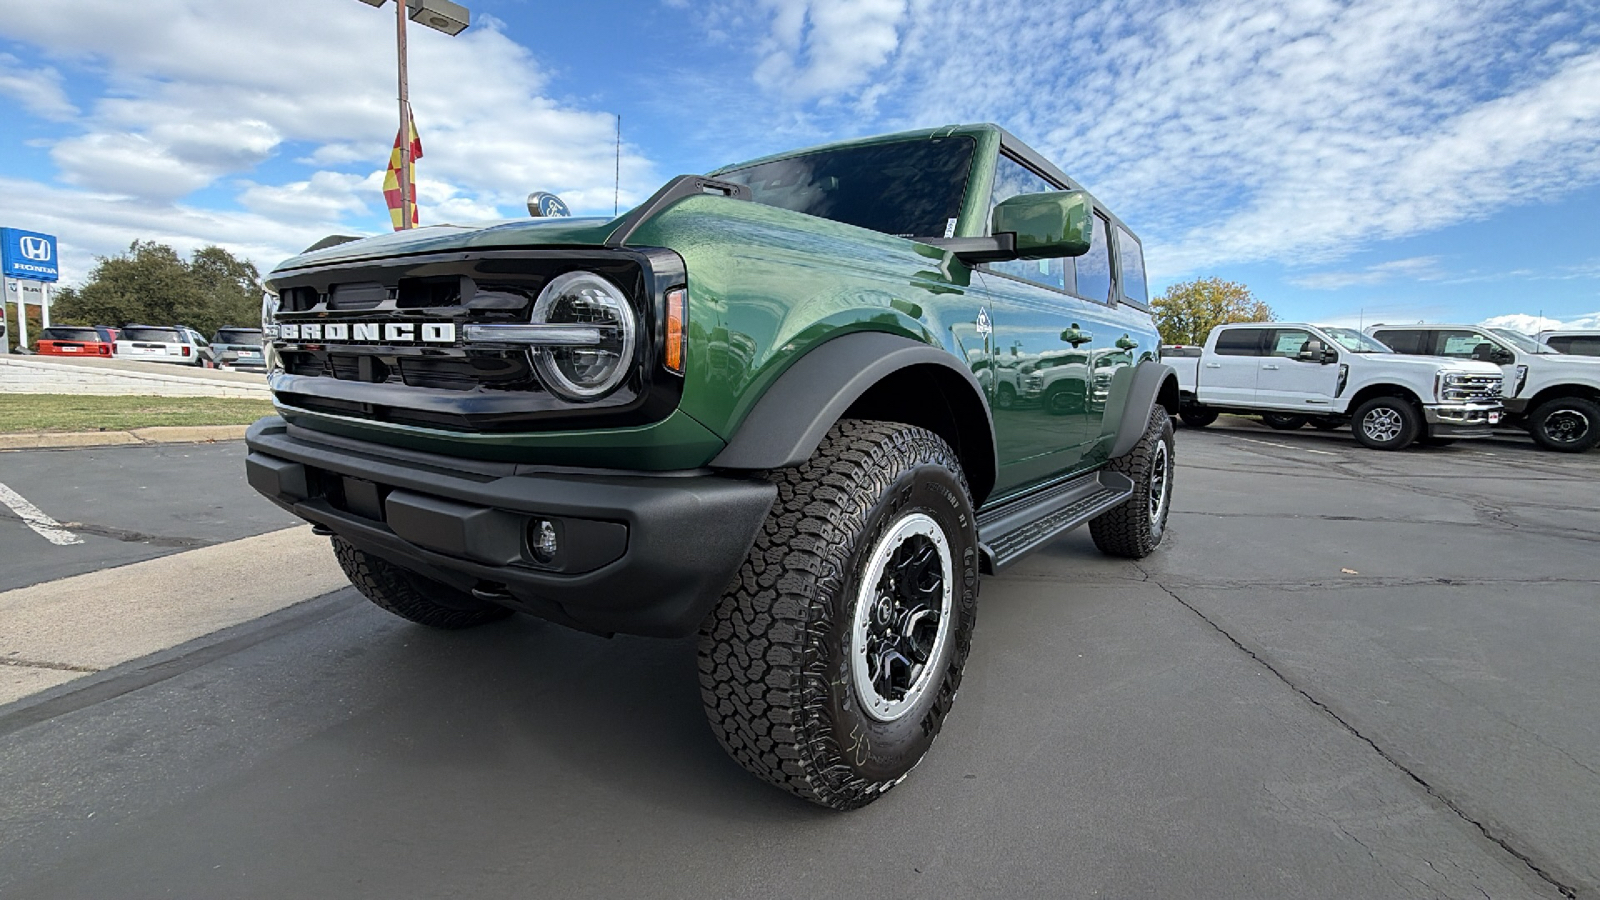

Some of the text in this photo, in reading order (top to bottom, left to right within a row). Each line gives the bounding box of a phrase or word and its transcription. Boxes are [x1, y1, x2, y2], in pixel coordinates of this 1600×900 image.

[13, 263, 57, 274] HONDA
[23, 286, 49, 294] RA
[281, 323, 456, 342] BRONCO
